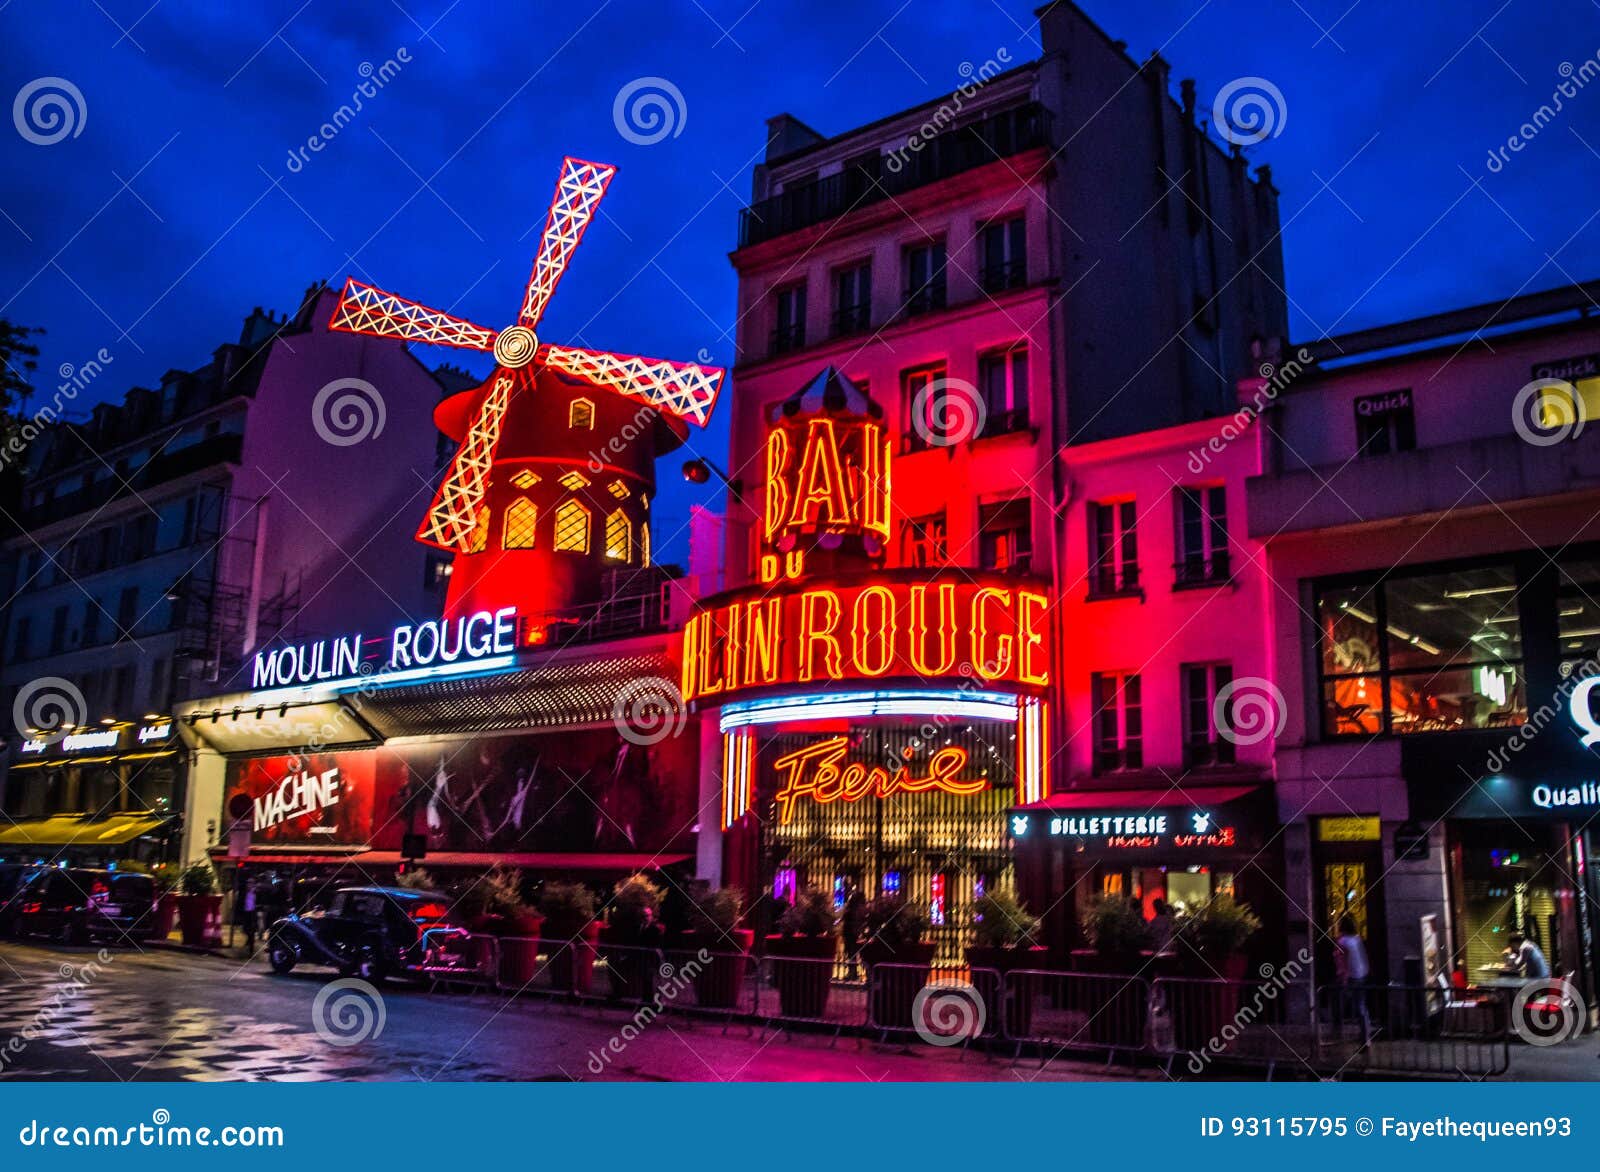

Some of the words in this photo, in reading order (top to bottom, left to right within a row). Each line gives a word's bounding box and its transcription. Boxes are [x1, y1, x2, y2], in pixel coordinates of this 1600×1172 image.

[1357, 392, 1410, 416] Quick
[765, 418, 892, 544] BAL
[761, 549, 803, 582] DU
[252, 634, 361, 688] MOULIN
[391, 606, 517, 668] ROUGE
[799, 584, 1049, 687] ROUGE
[253, 767, 339, 832] MACHINE
[1050, 815, 1167, 835] BILLETTERIE
